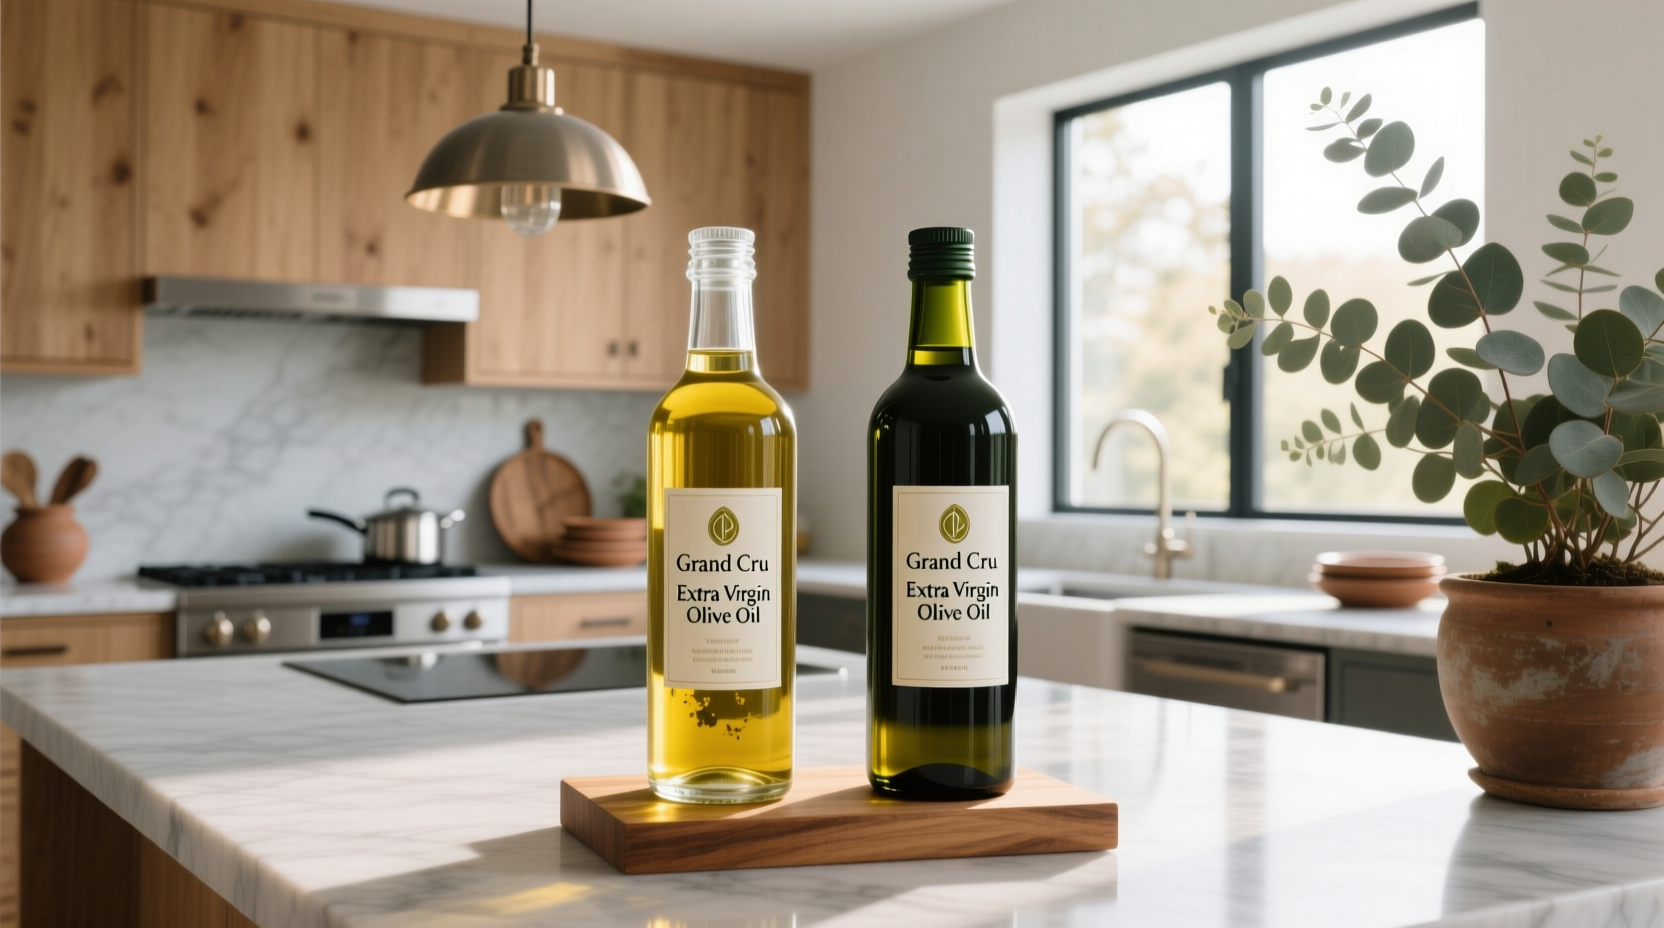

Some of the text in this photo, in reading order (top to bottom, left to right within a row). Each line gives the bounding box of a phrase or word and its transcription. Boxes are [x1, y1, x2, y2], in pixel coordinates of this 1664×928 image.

[676, 553, 769, 572] Grand Cru
[906, 551, 998, 570] Grand Cru
[677, 584, 770, 606] Extra Virgin
[906, 581, 999, 602] Extra Virgin
[686, 606, 760, 624] Olive Oil
[917, 603, 990, 621] Olive Oil
